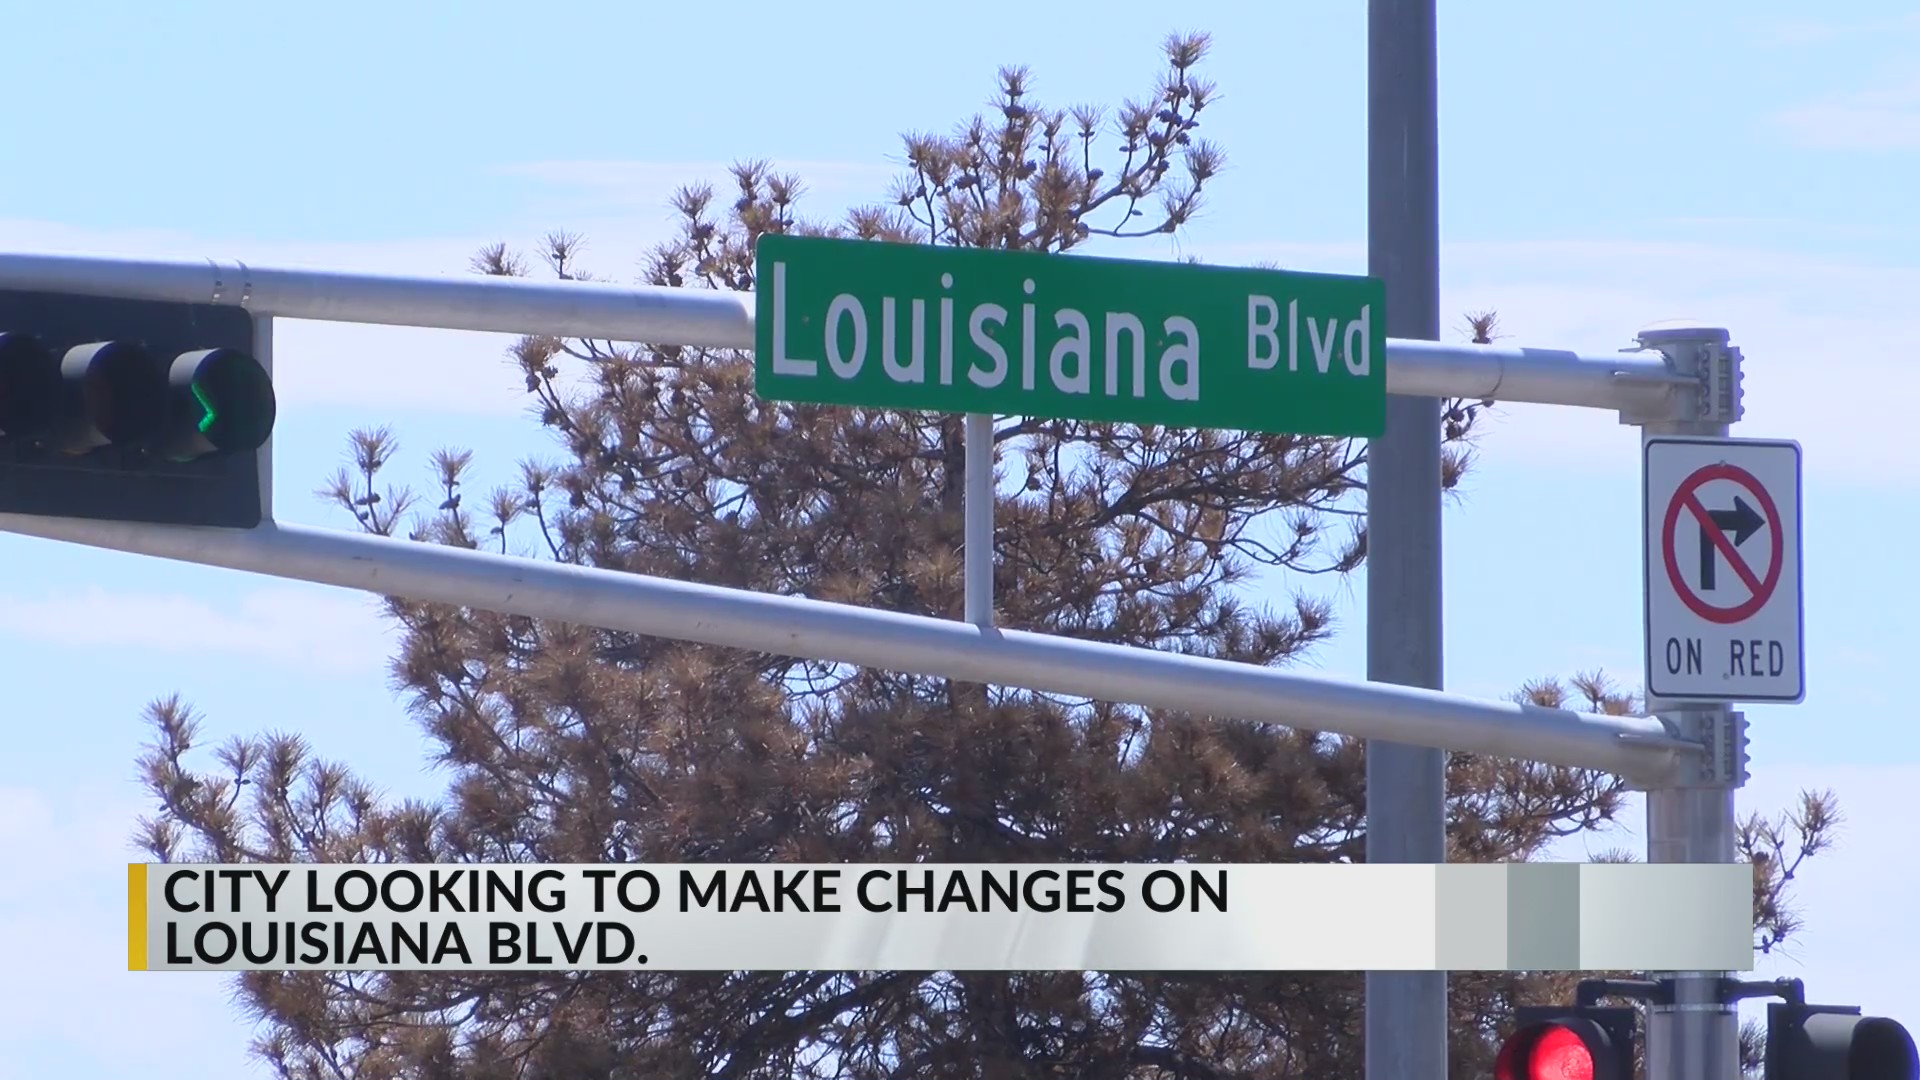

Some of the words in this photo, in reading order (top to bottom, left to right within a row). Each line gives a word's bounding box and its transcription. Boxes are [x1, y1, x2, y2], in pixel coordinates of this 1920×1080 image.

[772, 261, 1200, 402] Louisiana
[1247, 294, 1371, 376] Blvd
[1665, 636, 1703, 676] ON
[1729, 639, 1785, 678] RED
